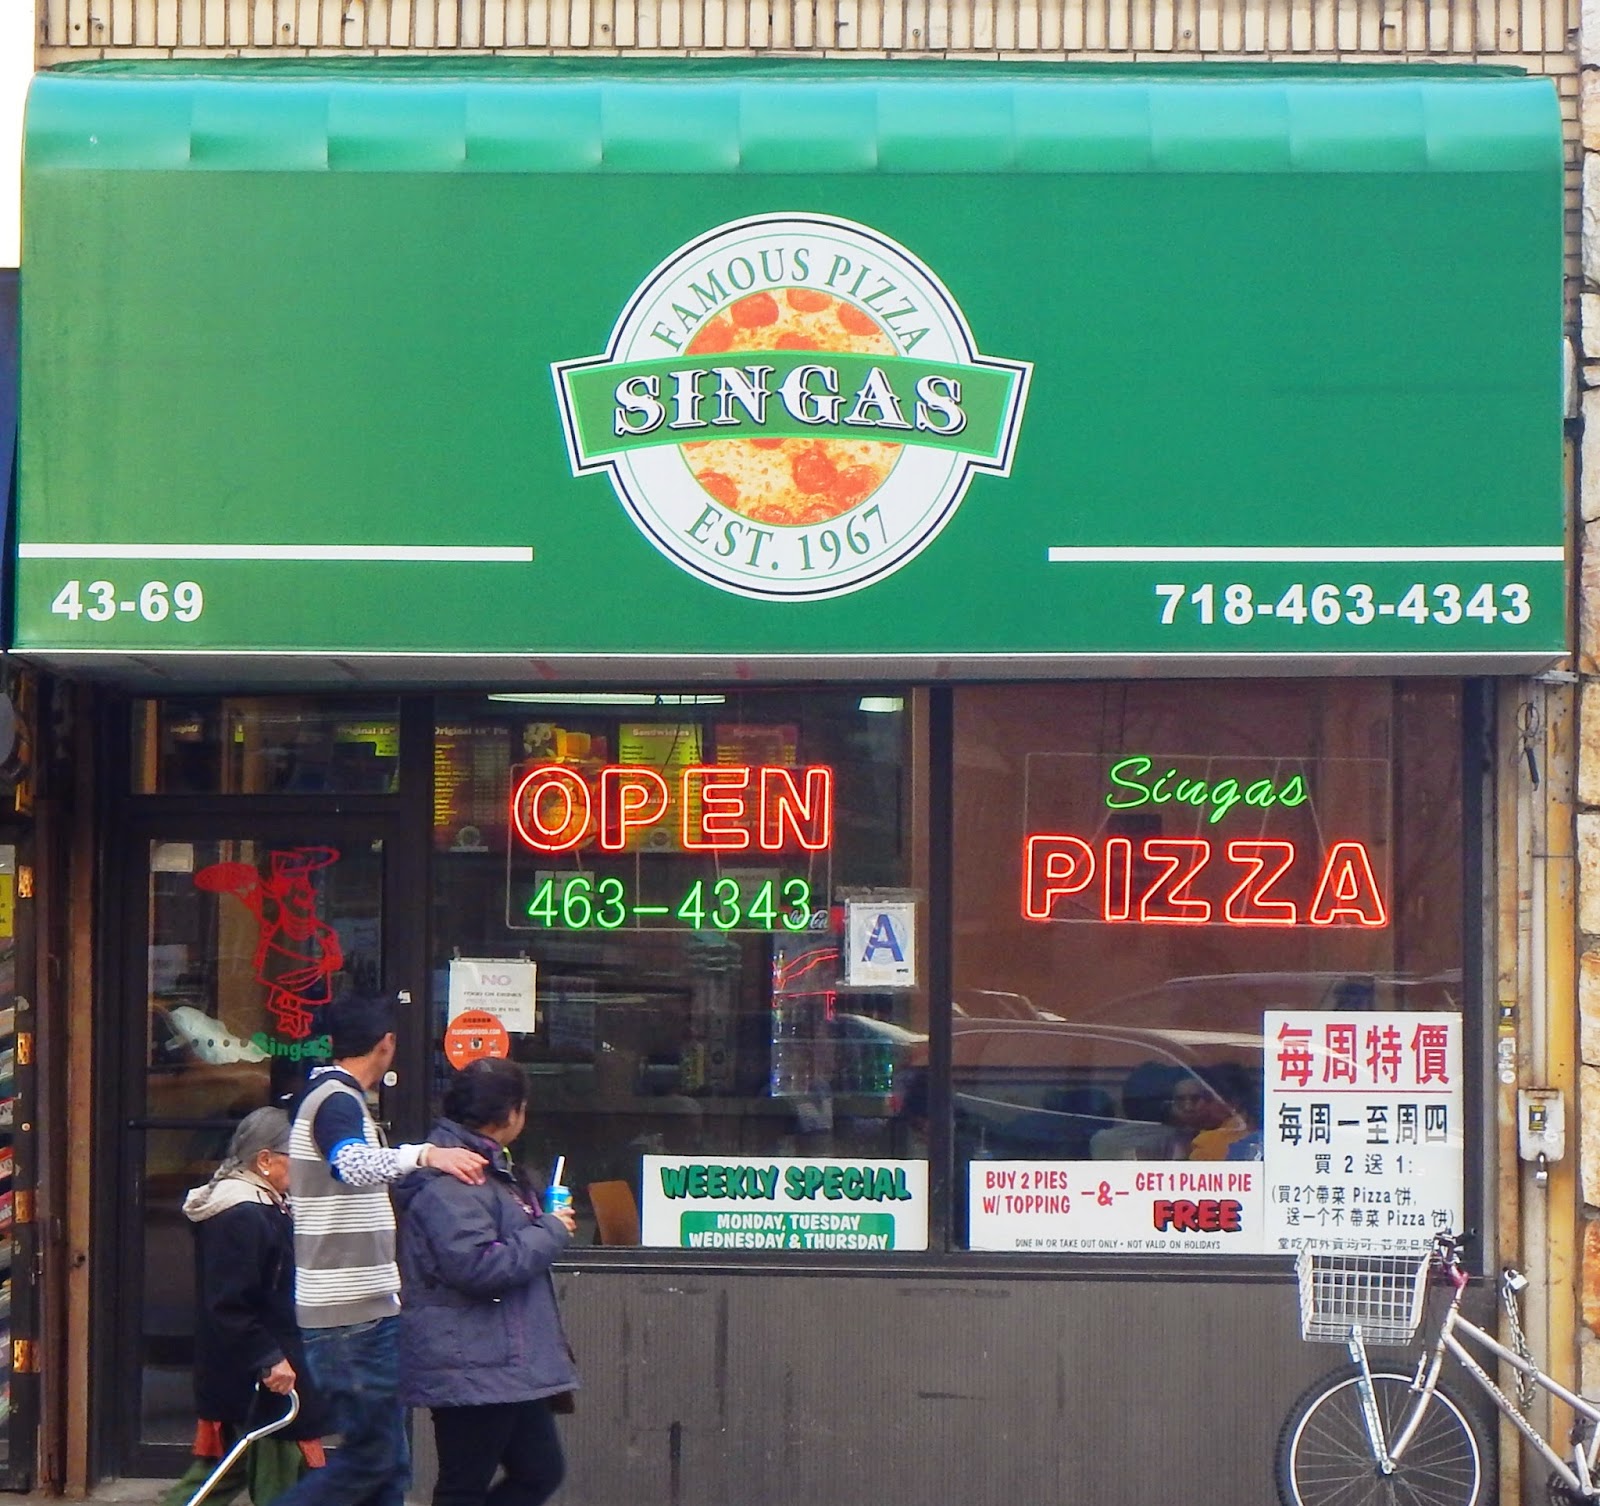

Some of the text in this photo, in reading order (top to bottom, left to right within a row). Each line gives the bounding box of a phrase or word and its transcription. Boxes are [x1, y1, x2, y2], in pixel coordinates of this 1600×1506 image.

[650, 248, 931, 354] FAMOUS PIZZA
[613, 364, 967, 436] SINGAS
[684, 502, 890, 571] EST. 1967
[51, 580, 204, 622] 43-69
[1154, 583, 1532, 625] 718-463-4343
[511, 763, 832, 851] OPEN
[1105, 755, 1308, 824] Singas
[1024, 834, 1390, 927] PIZZA
[527, 877, 814, 931] 463-4343
[861, 913, 905, 962] A
[481, 974, 512, 986] NO
[252, 1032, 333, 1062] Singas
[1277, 1022, 1451, 1087] 每周特價
[1278, 1102, 1448, 1147] 每周一至周四
[660, 1164, 912, 1201] WEEKLY SPECIAL
[985, 1170, 1068, 1190] BUY 2 PIES
[1135, 1173, 1253, 1192] GET 1 PLAIN PIE
[717, 1213, 861, 1231] MONDAY, TUESDAY
[983, 1195, 1071, 1216] W/ TOPPING
[1153, 1199, 1243, 1233] FREE
[688, 1232, 888, 1250] WEDNESDAY & THURSDAY
[1015, 1238, 1221, 1250] DINE IN OR TAKE OUT ONLY NOT VALID ON HOLIDAYS
